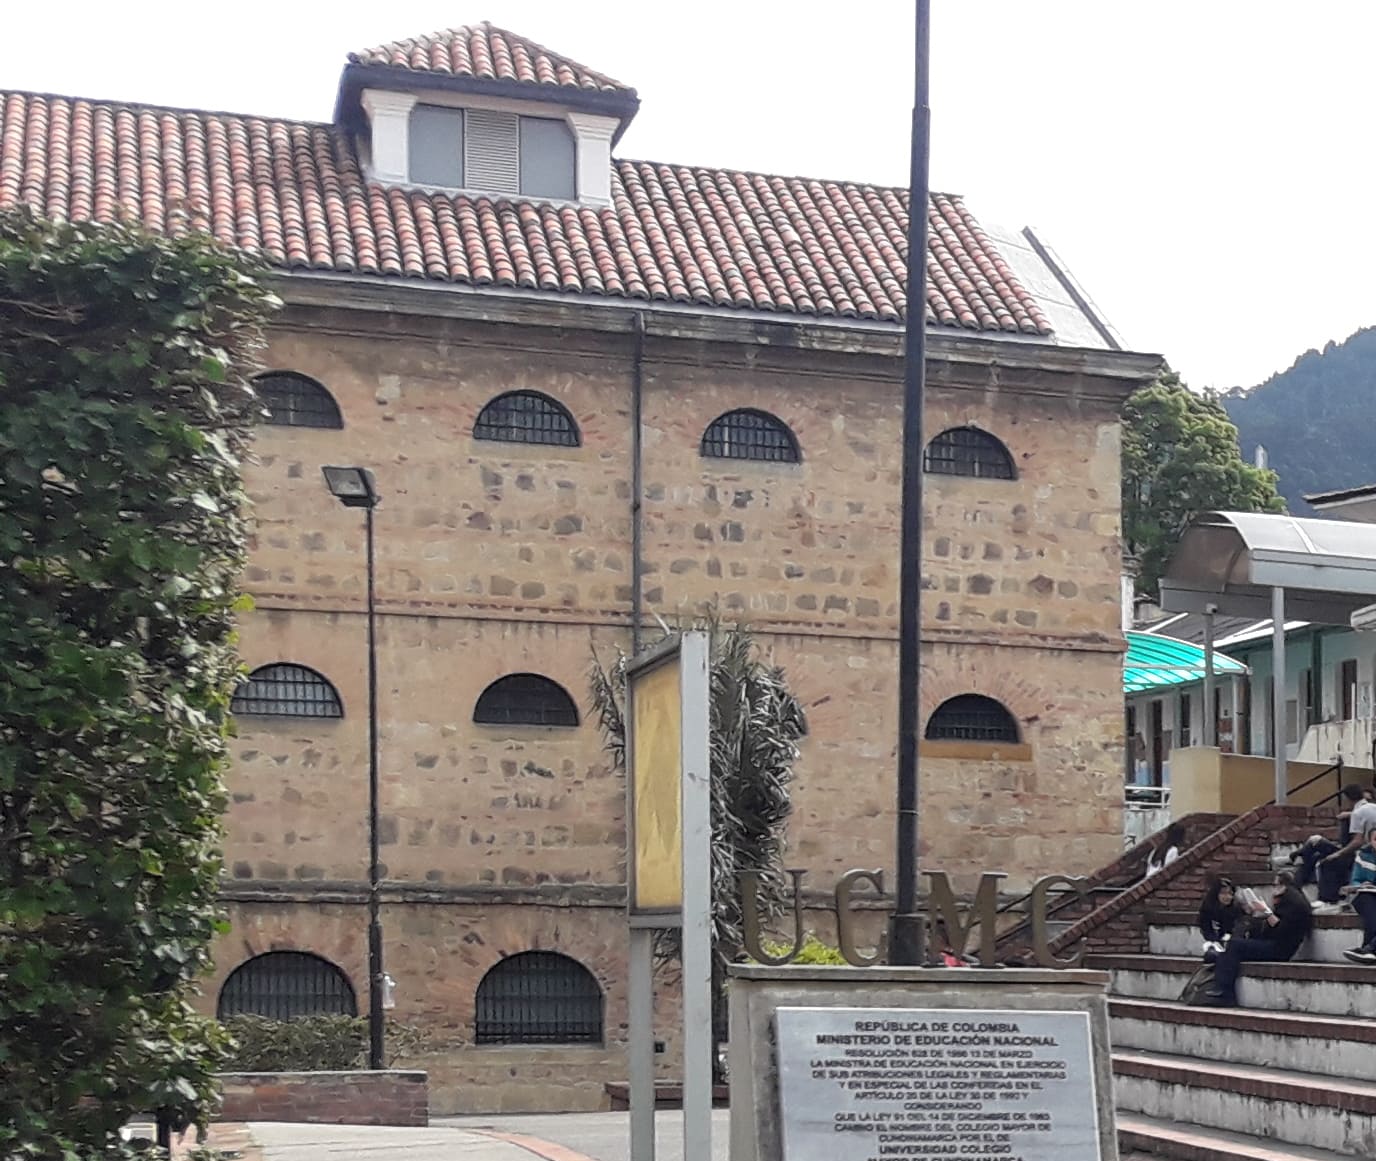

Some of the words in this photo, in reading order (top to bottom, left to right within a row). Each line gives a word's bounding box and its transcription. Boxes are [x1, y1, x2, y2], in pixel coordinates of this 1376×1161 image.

[737, 868, 1090, 970] UCMC
[856, 1020, 928, 1032] REPÚBLICA
[932, 1022, 950, 1032] DE
[952, 1022, 1020, 1033] COLOMBIA
[816, 1034, 890, 1045] MINISTERIO
[894, 1035, 912, 1046] DE
[914, 1034, 990, 1046] EDUCACIÓN
[992, 1036, 1058, 1047] NACIONAL
[872, 1060, 888, 1068] DE
[960, 1144, 1012, 1154] COLEGIO
